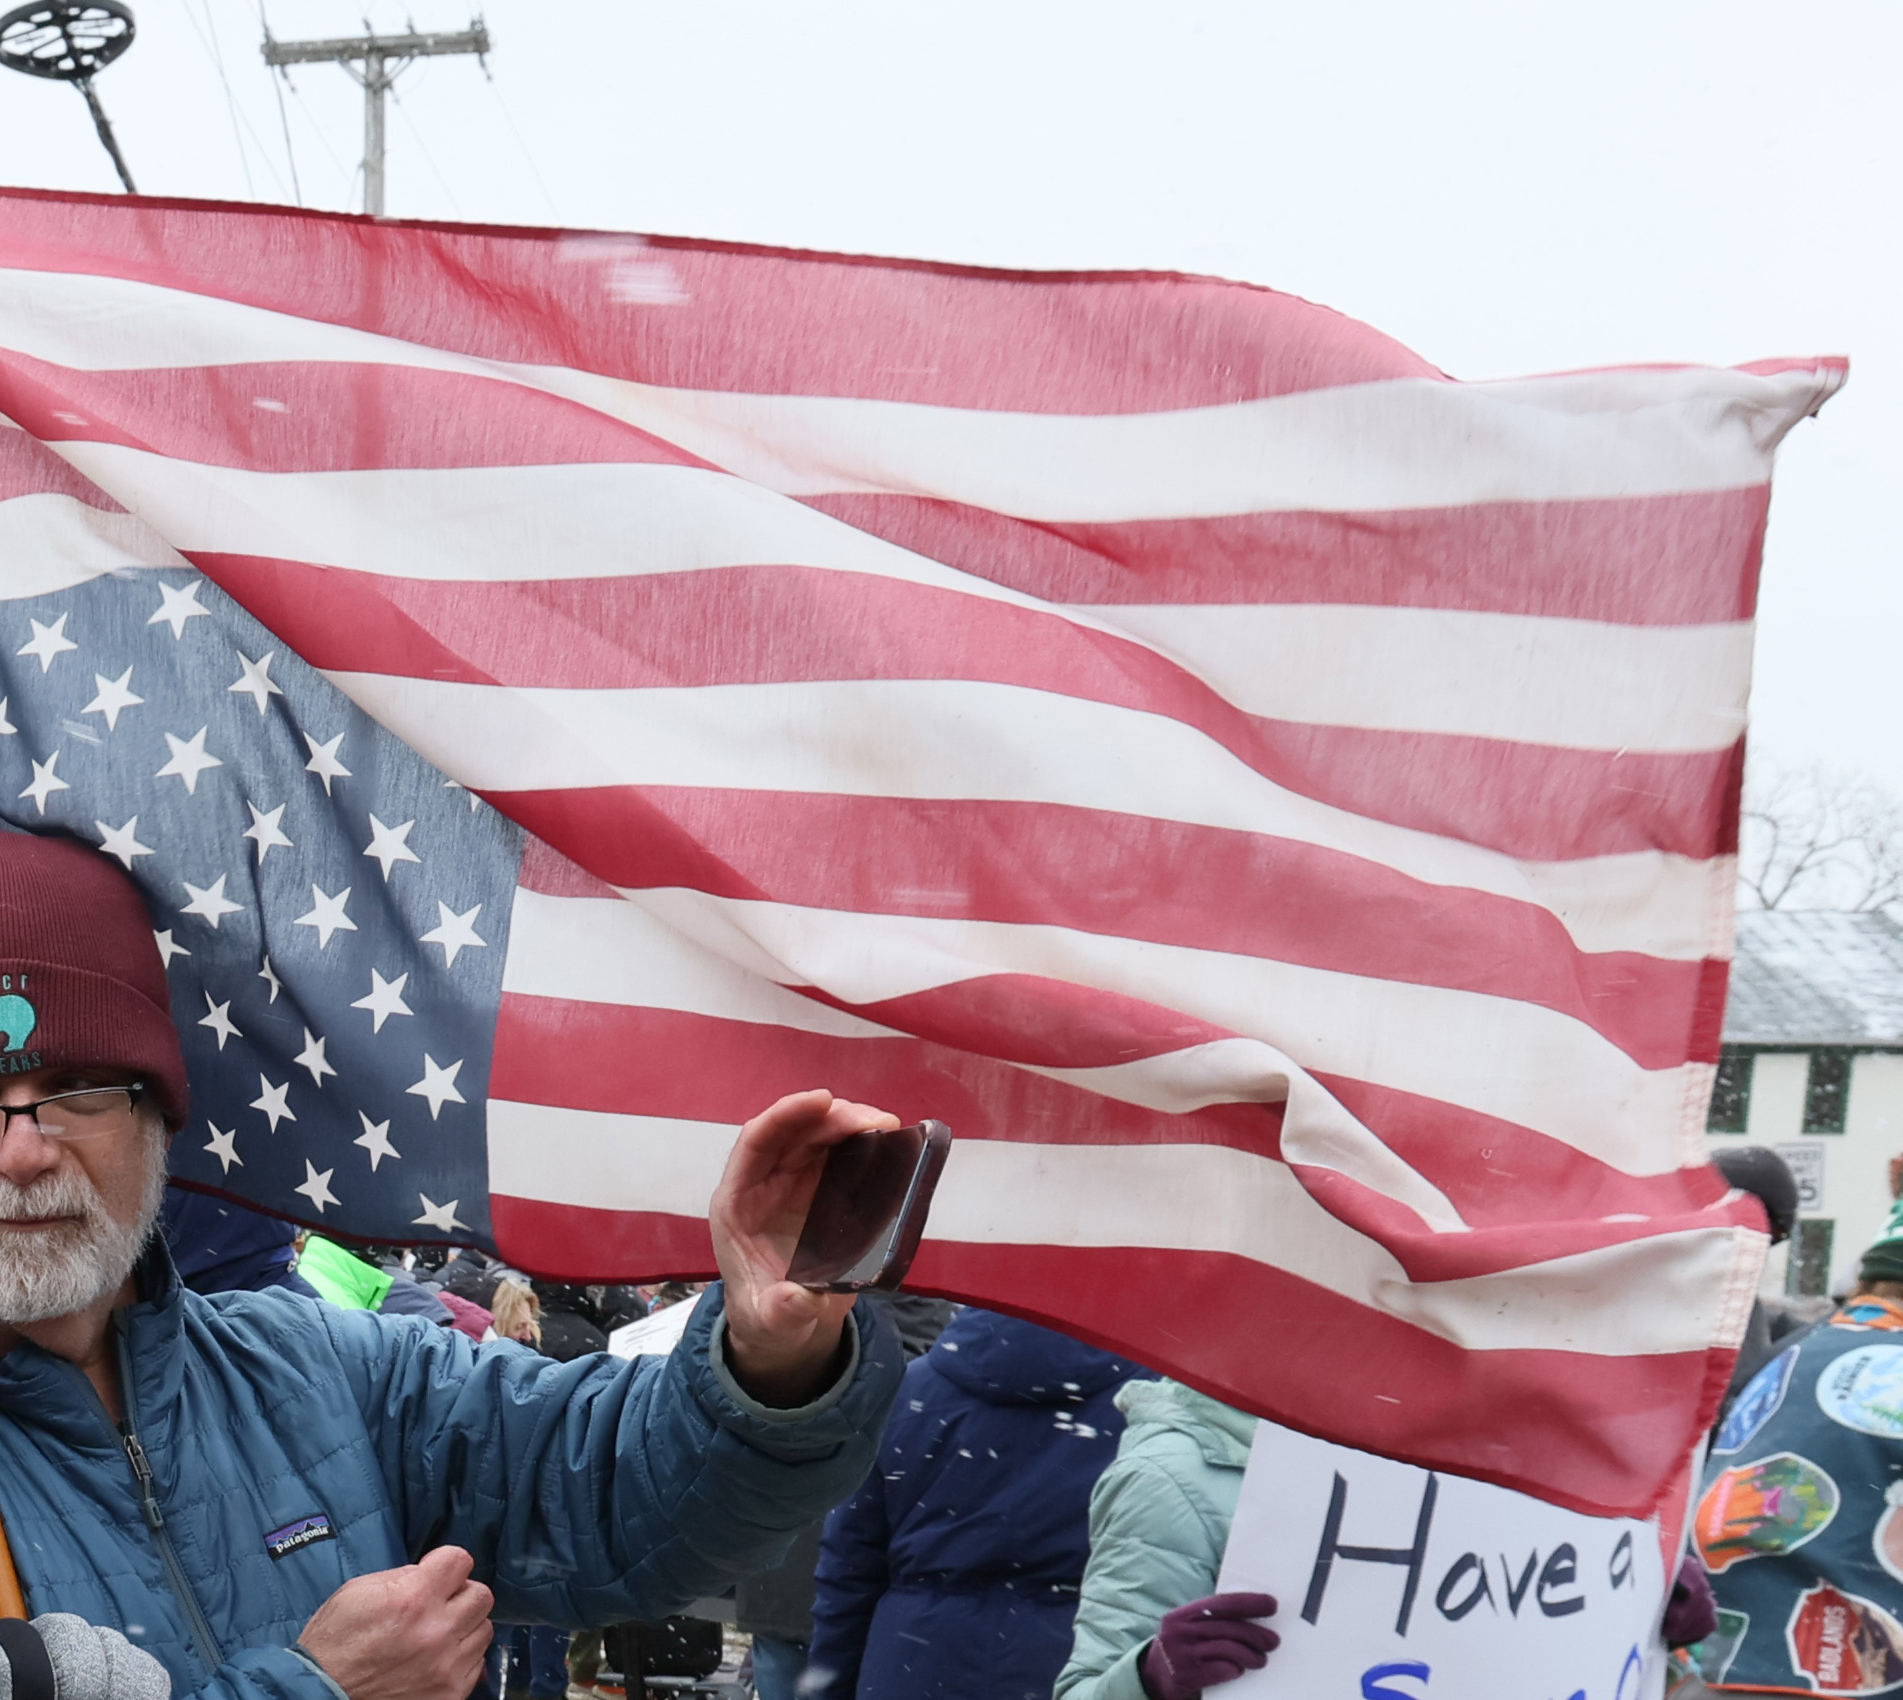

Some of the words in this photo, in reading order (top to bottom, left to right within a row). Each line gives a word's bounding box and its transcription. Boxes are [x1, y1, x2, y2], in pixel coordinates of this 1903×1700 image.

[276, 1526, 329, 1553] patagonia
[1299, 1468, 1586, 1638] Have
[1608, 1529, 1638, 1592] a
[1818, 1604, 1846, 1682] BADLANDS
